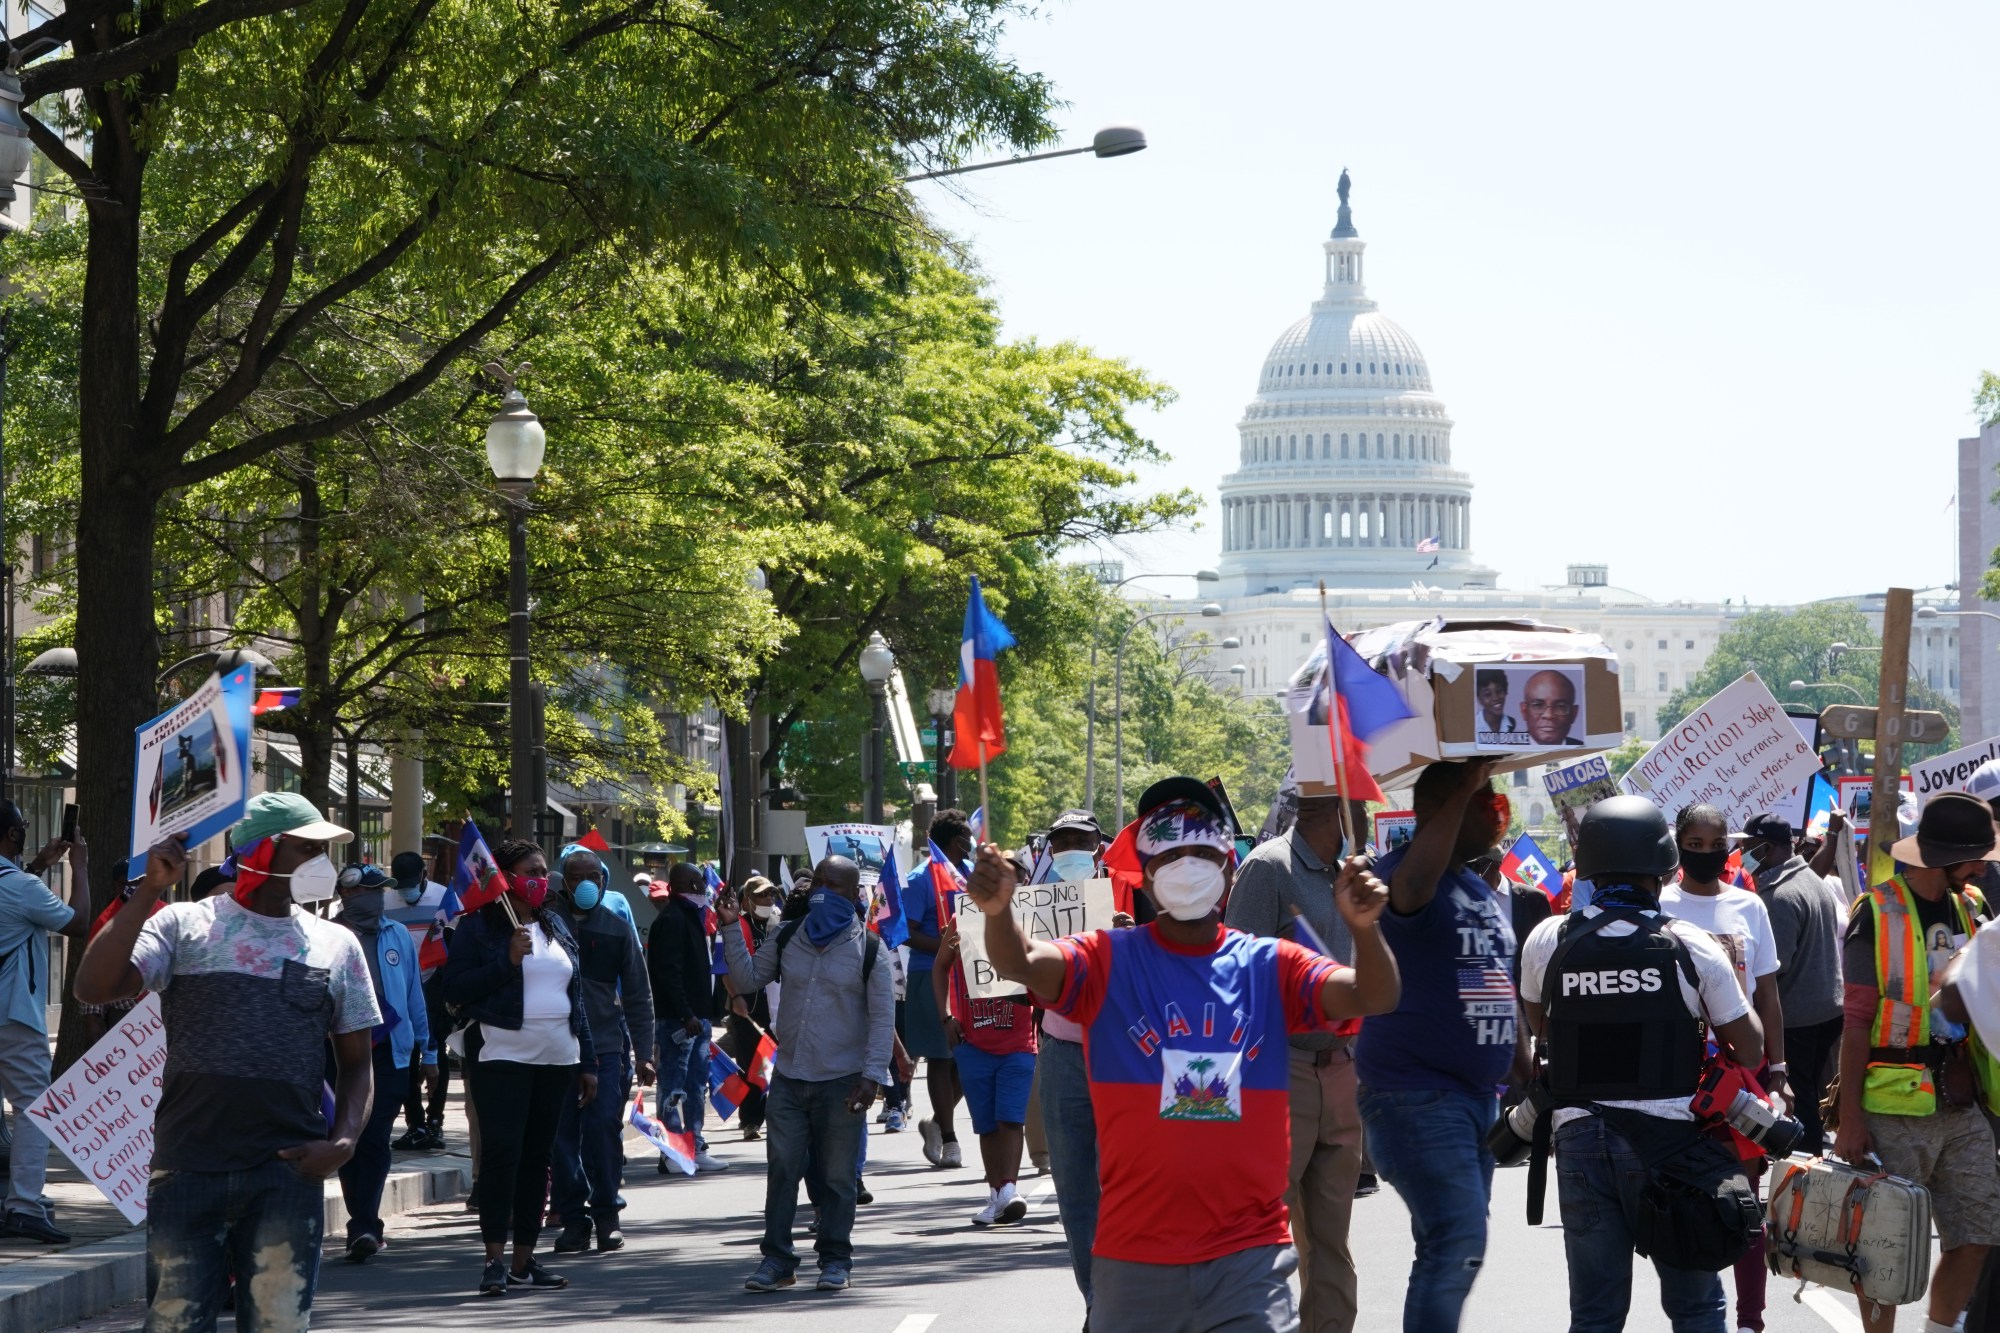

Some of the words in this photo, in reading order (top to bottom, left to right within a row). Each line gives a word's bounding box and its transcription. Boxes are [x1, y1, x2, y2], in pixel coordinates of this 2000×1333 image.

[1544, 770, 1568, 793] UN
[1566, 774, 1574, 784] &
[1574, 758, 1607, 783] OAS
[834, 829, 885, 837] CHANCE
[1457, 928, 1498, 956] THE
[1562, 968, 1662, 997] PRESS
[1474, 1004, 1490, 1013] MY
[1126, 1001, 1266, 1062] HAITI
[30, 1081, 78, 1122] Why
[54, 1085, 122, 1144] Harris
